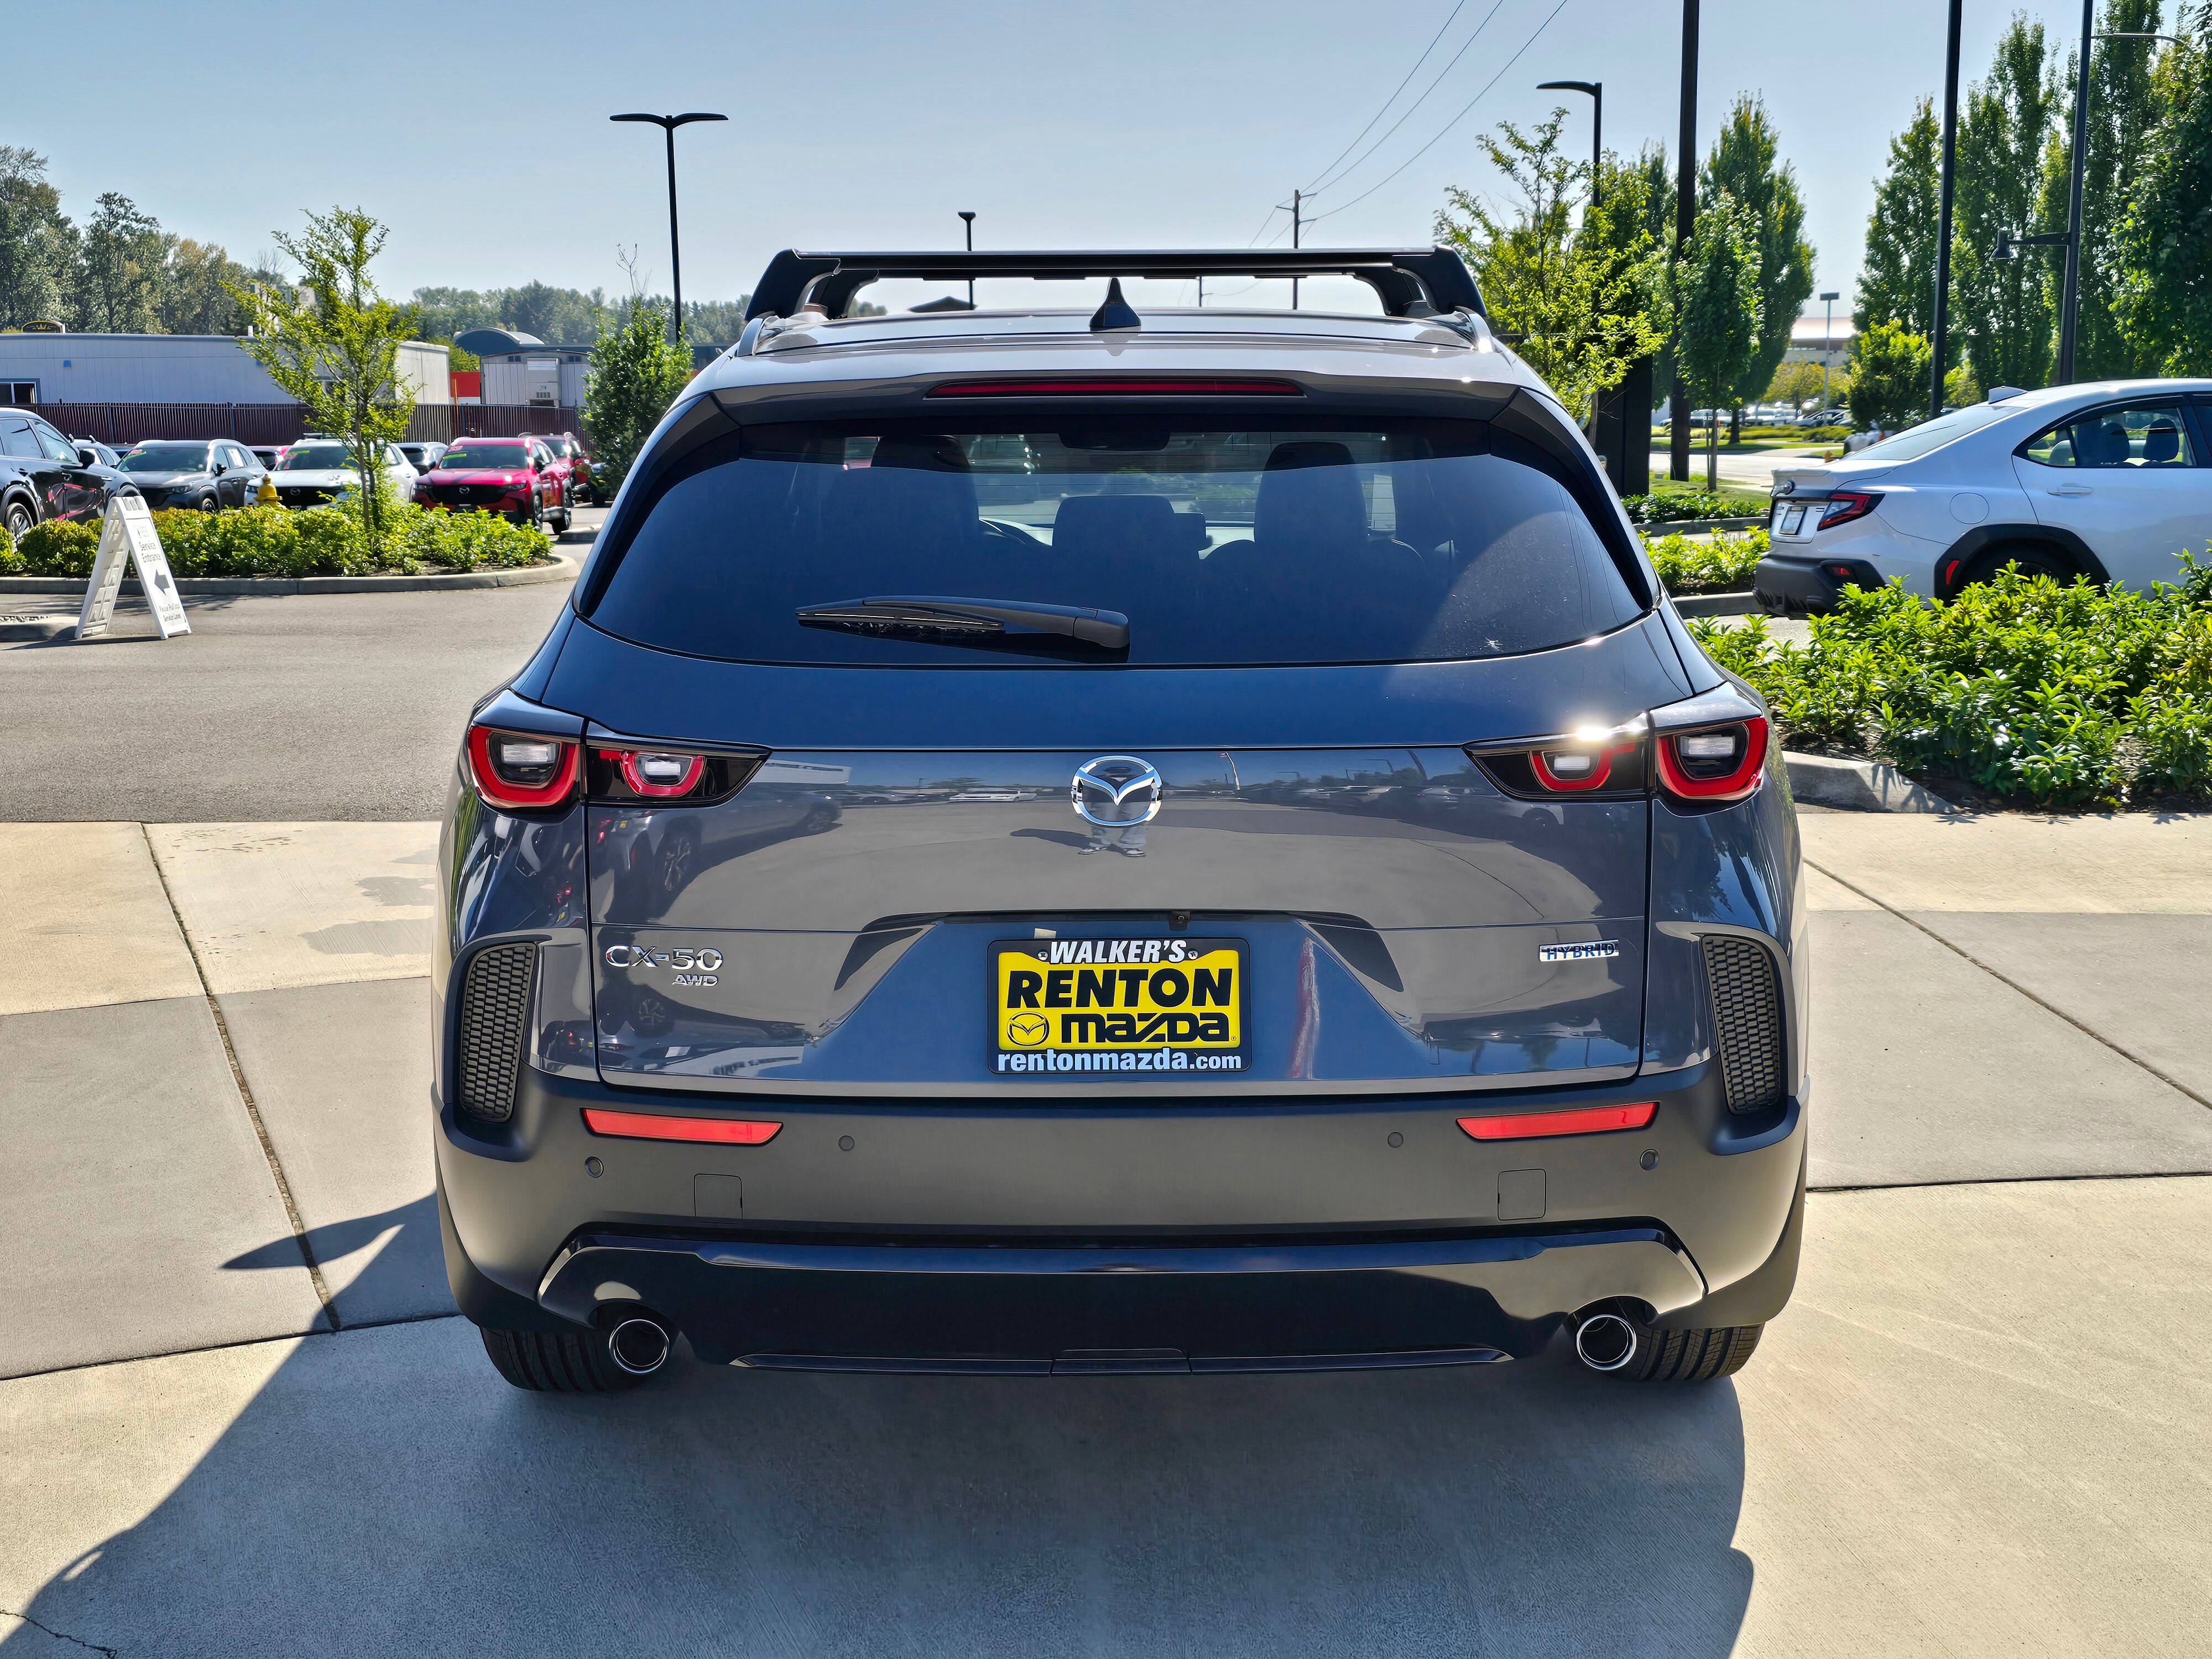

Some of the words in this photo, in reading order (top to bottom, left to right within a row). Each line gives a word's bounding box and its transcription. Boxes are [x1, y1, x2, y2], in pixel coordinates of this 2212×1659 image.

[606, 945, 723, 971] CX-50
[1051, 940, 1187, 963] WALKER'S
[1547, 942, 1616, 960] HYBRID
[672, 974, 718, 987] AWD
[1006, 968, 1233, 1008] RENTON
[998, 1047, 1241, 1071] rentonmazda.com
